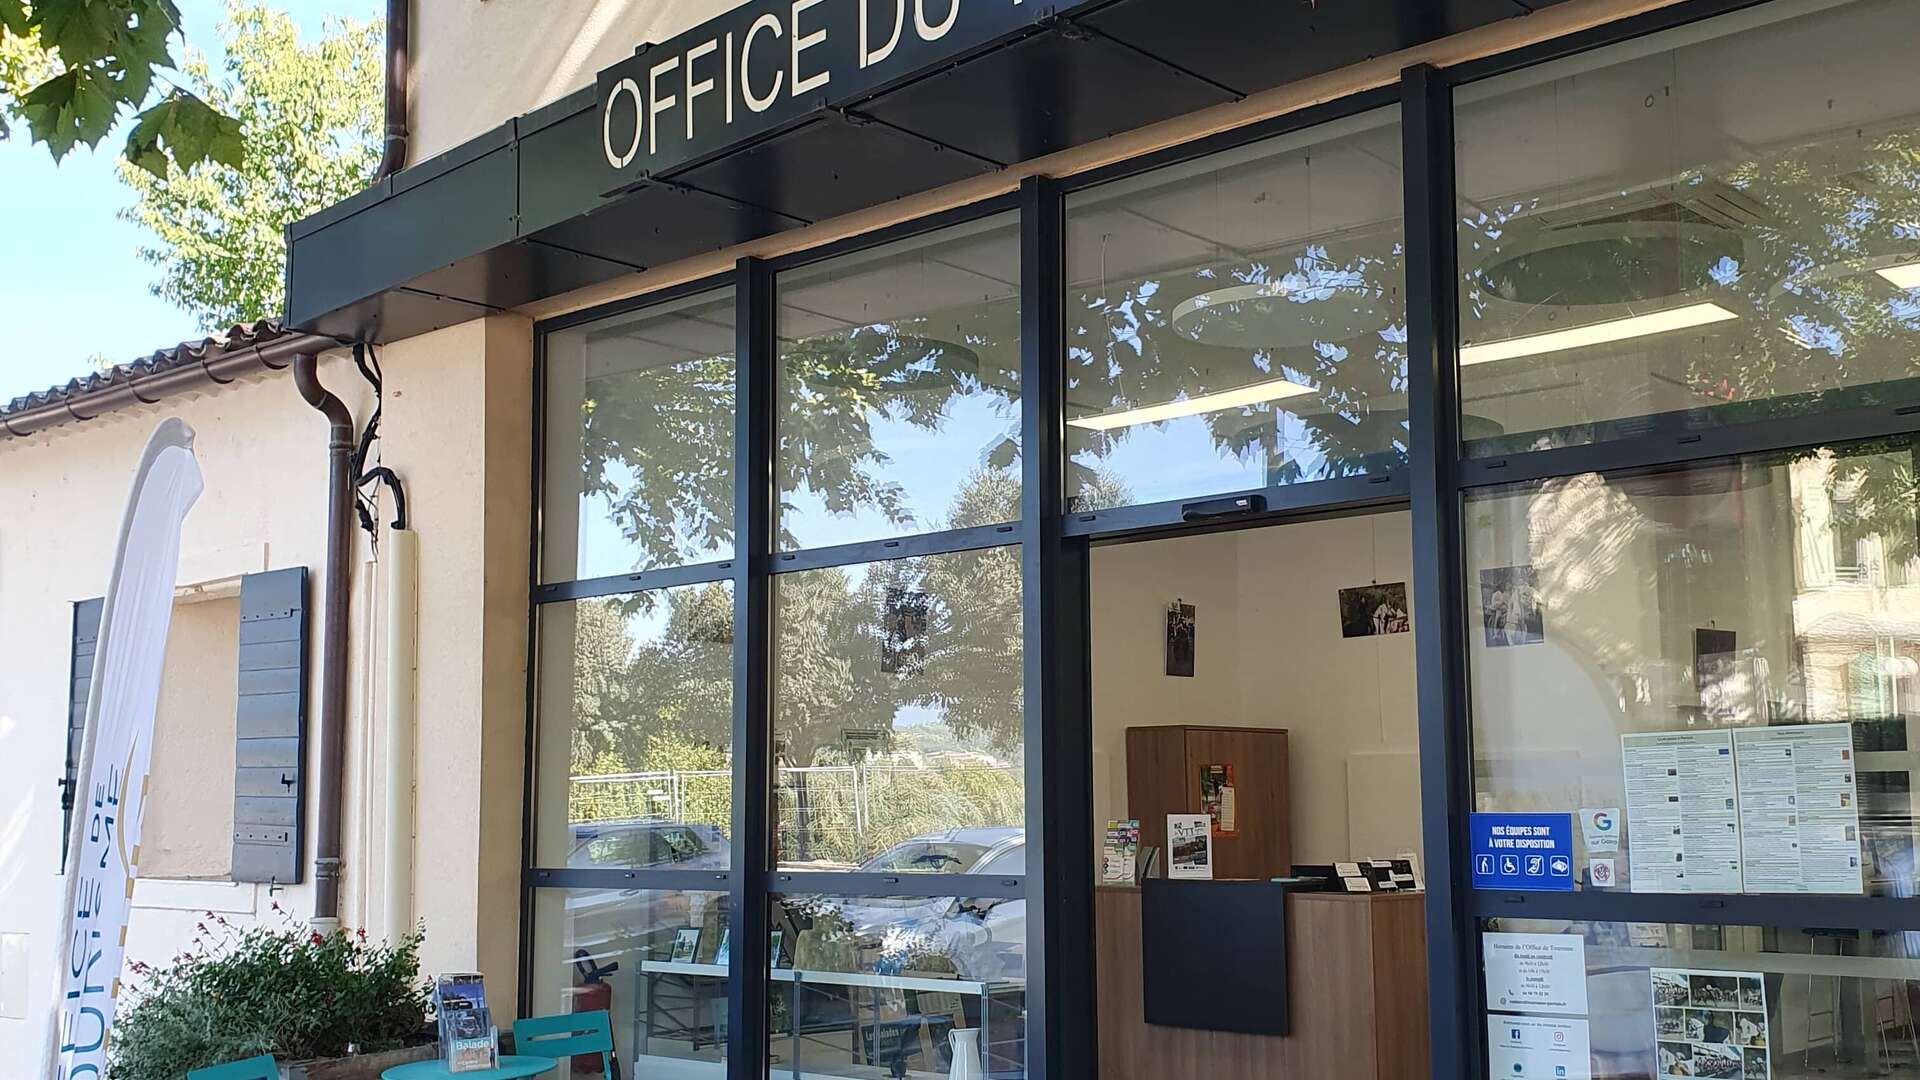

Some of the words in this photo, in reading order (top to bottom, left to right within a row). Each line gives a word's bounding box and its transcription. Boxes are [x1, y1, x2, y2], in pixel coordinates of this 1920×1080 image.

[603, 0, 830, 169] OFFICE
[1492, 826, 1504, 836] NOS
[1506, 824, 1532, 836] ÉQUIPES
[1533, 826, 1550, 836] SONT
[1489, 837, 1494, 848] À
[1494, 839, 1515, 849] VOTRE
[1515, 839, 1555, 849] DISPOSITION
